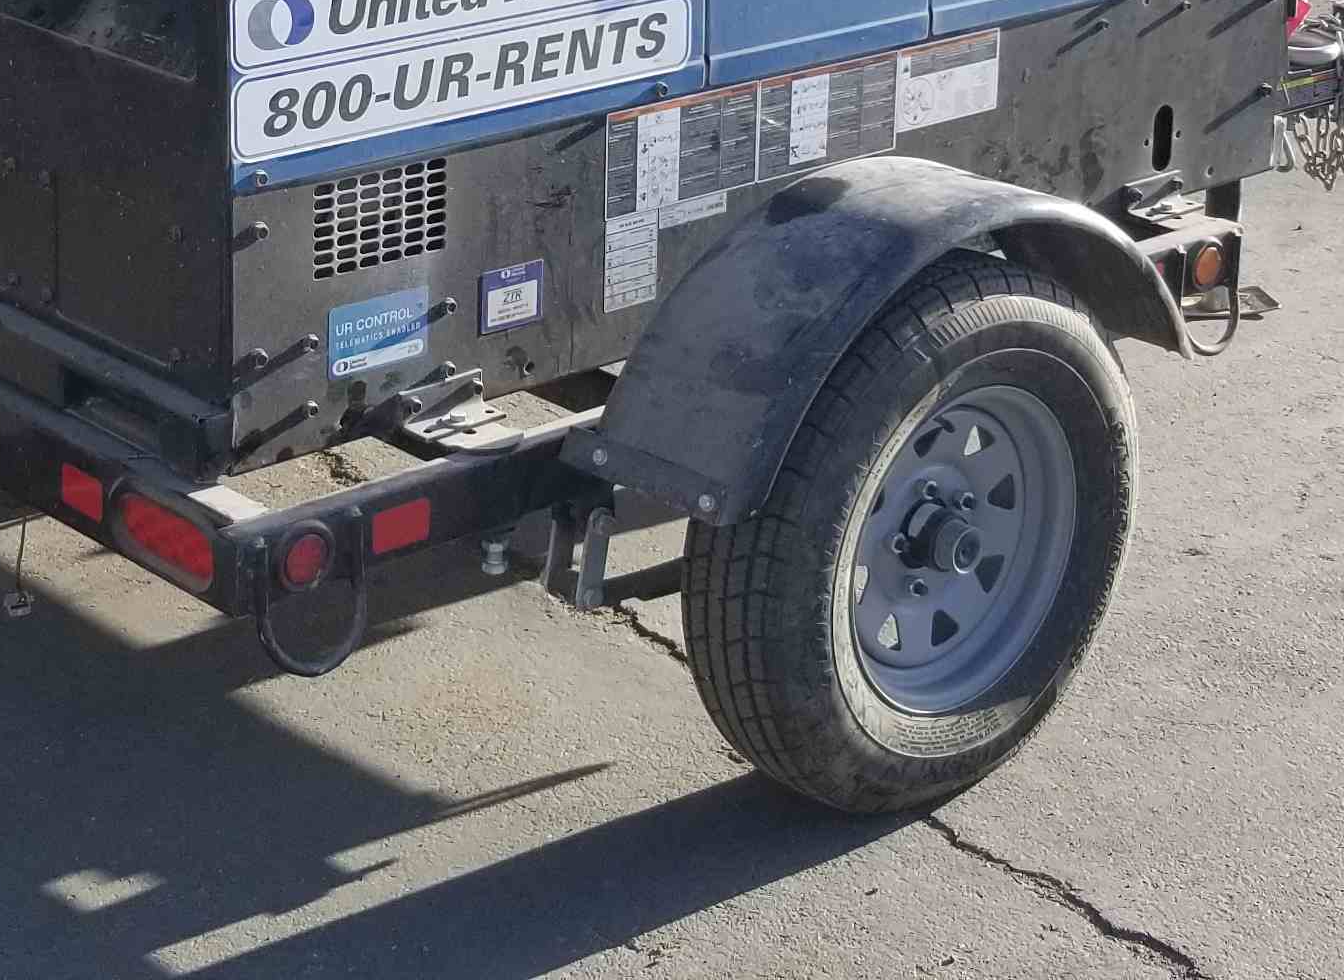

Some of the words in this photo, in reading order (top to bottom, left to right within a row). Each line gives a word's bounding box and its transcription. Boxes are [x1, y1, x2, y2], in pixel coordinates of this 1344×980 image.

[262, 12, 668, 139] 800-UR-RENTS
[336, 322, 353, 337] UR
[356, 307, 414, 331] CONTROL
